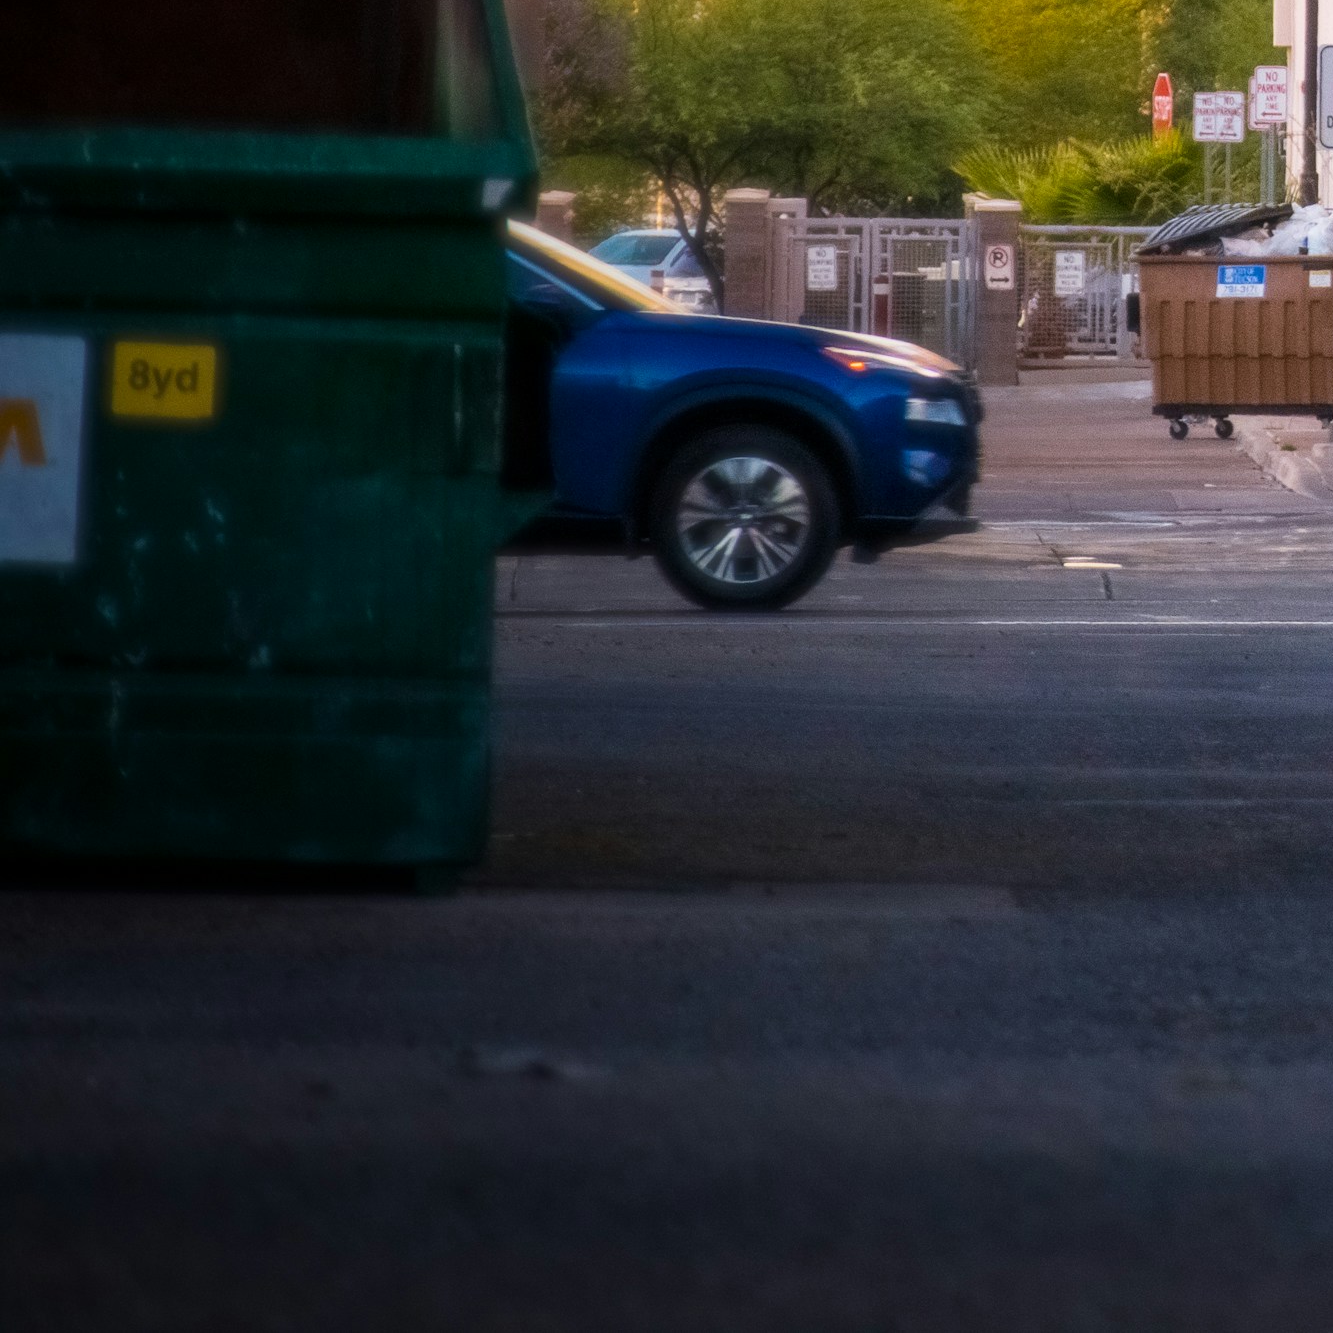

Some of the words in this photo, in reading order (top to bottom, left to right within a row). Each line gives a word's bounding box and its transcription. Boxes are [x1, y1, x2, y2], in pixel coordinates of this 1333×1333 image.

[1265, 71, 1278, 82] NO
[1257, 84, 1286, 94] PARKING
[128, 358, 199, 400] 8yd
